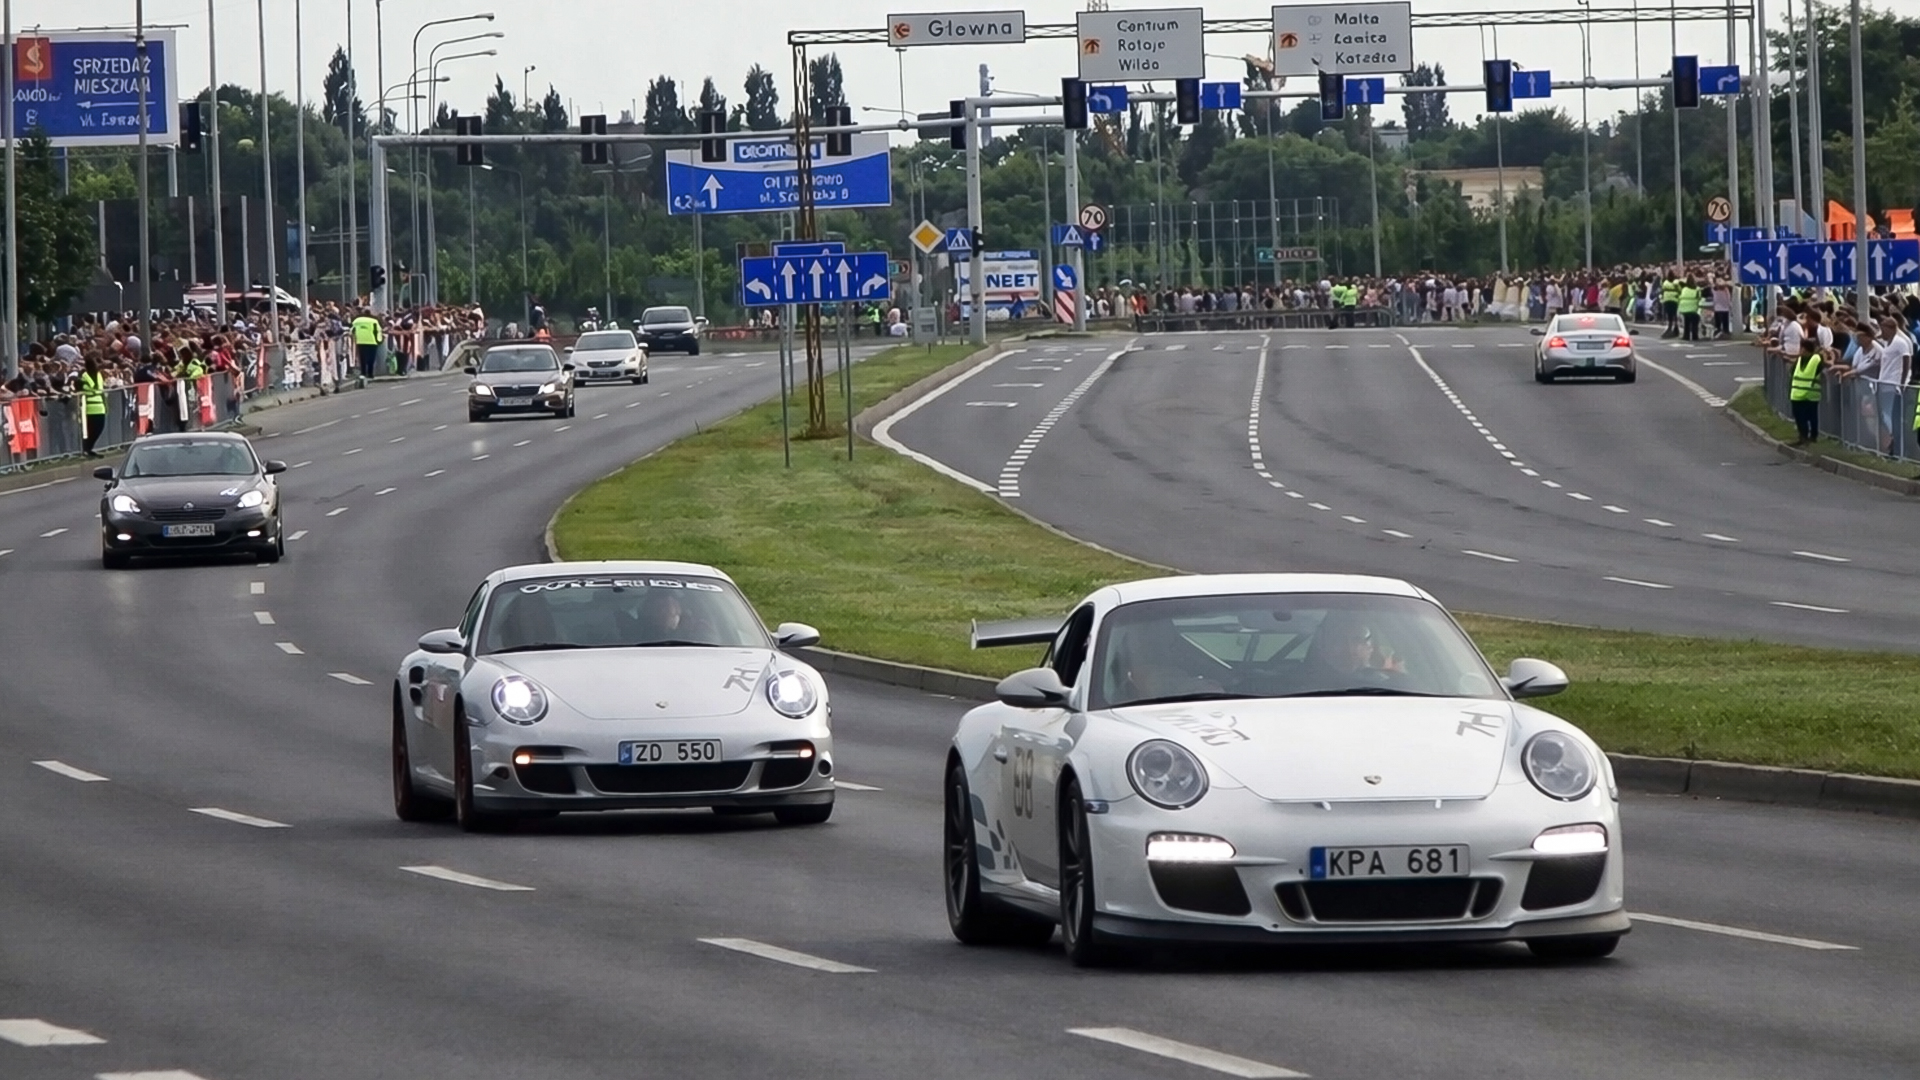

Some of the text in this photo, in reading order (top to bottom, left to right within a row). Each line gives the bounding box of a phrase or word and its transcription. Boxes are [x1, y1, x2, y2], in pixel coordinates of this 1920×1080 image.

[1335, 13, 1379, 25] Malta
[1084, 209, 1104, 225] 70
[635, 741, 715, 762] ZD 550
[1329, 848, 1459, 876] KPA 681
